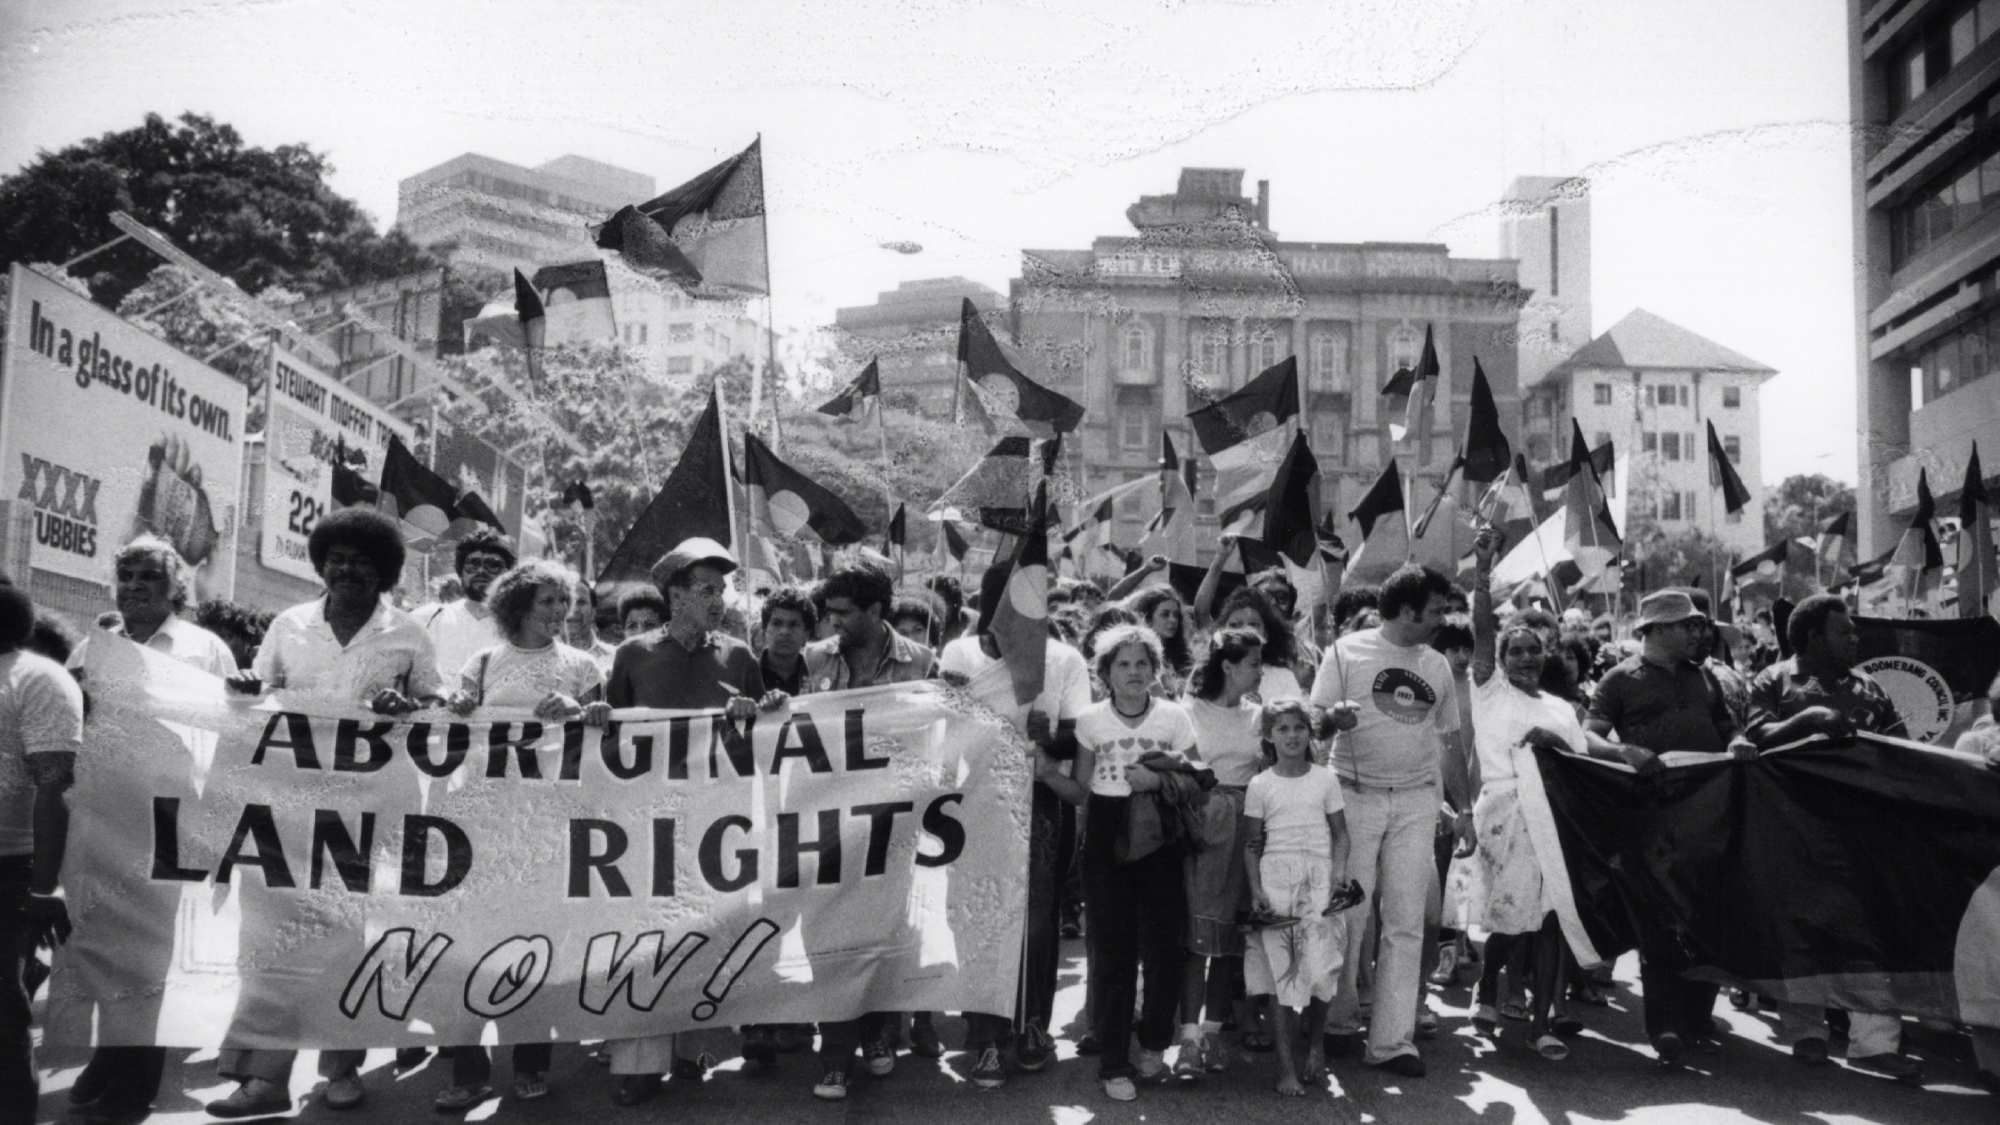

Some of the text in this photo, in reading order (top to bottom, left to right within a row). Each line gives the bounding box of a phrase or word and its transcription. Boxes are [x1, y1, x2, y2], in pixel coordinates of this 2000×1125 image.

[30, 300, 232, 443] In a glass of its own.
[276, 361, 327, 415] STEWART
[18, 453, 101, 526] XXXX
[1863, 660, 1927, 679] BOOMERANG
[251, 709, 891, 779] ABORIGINAL
[151, 793, 966, 898] LAND RIGHTS
[338, 917, 780, 1021] NOW!
